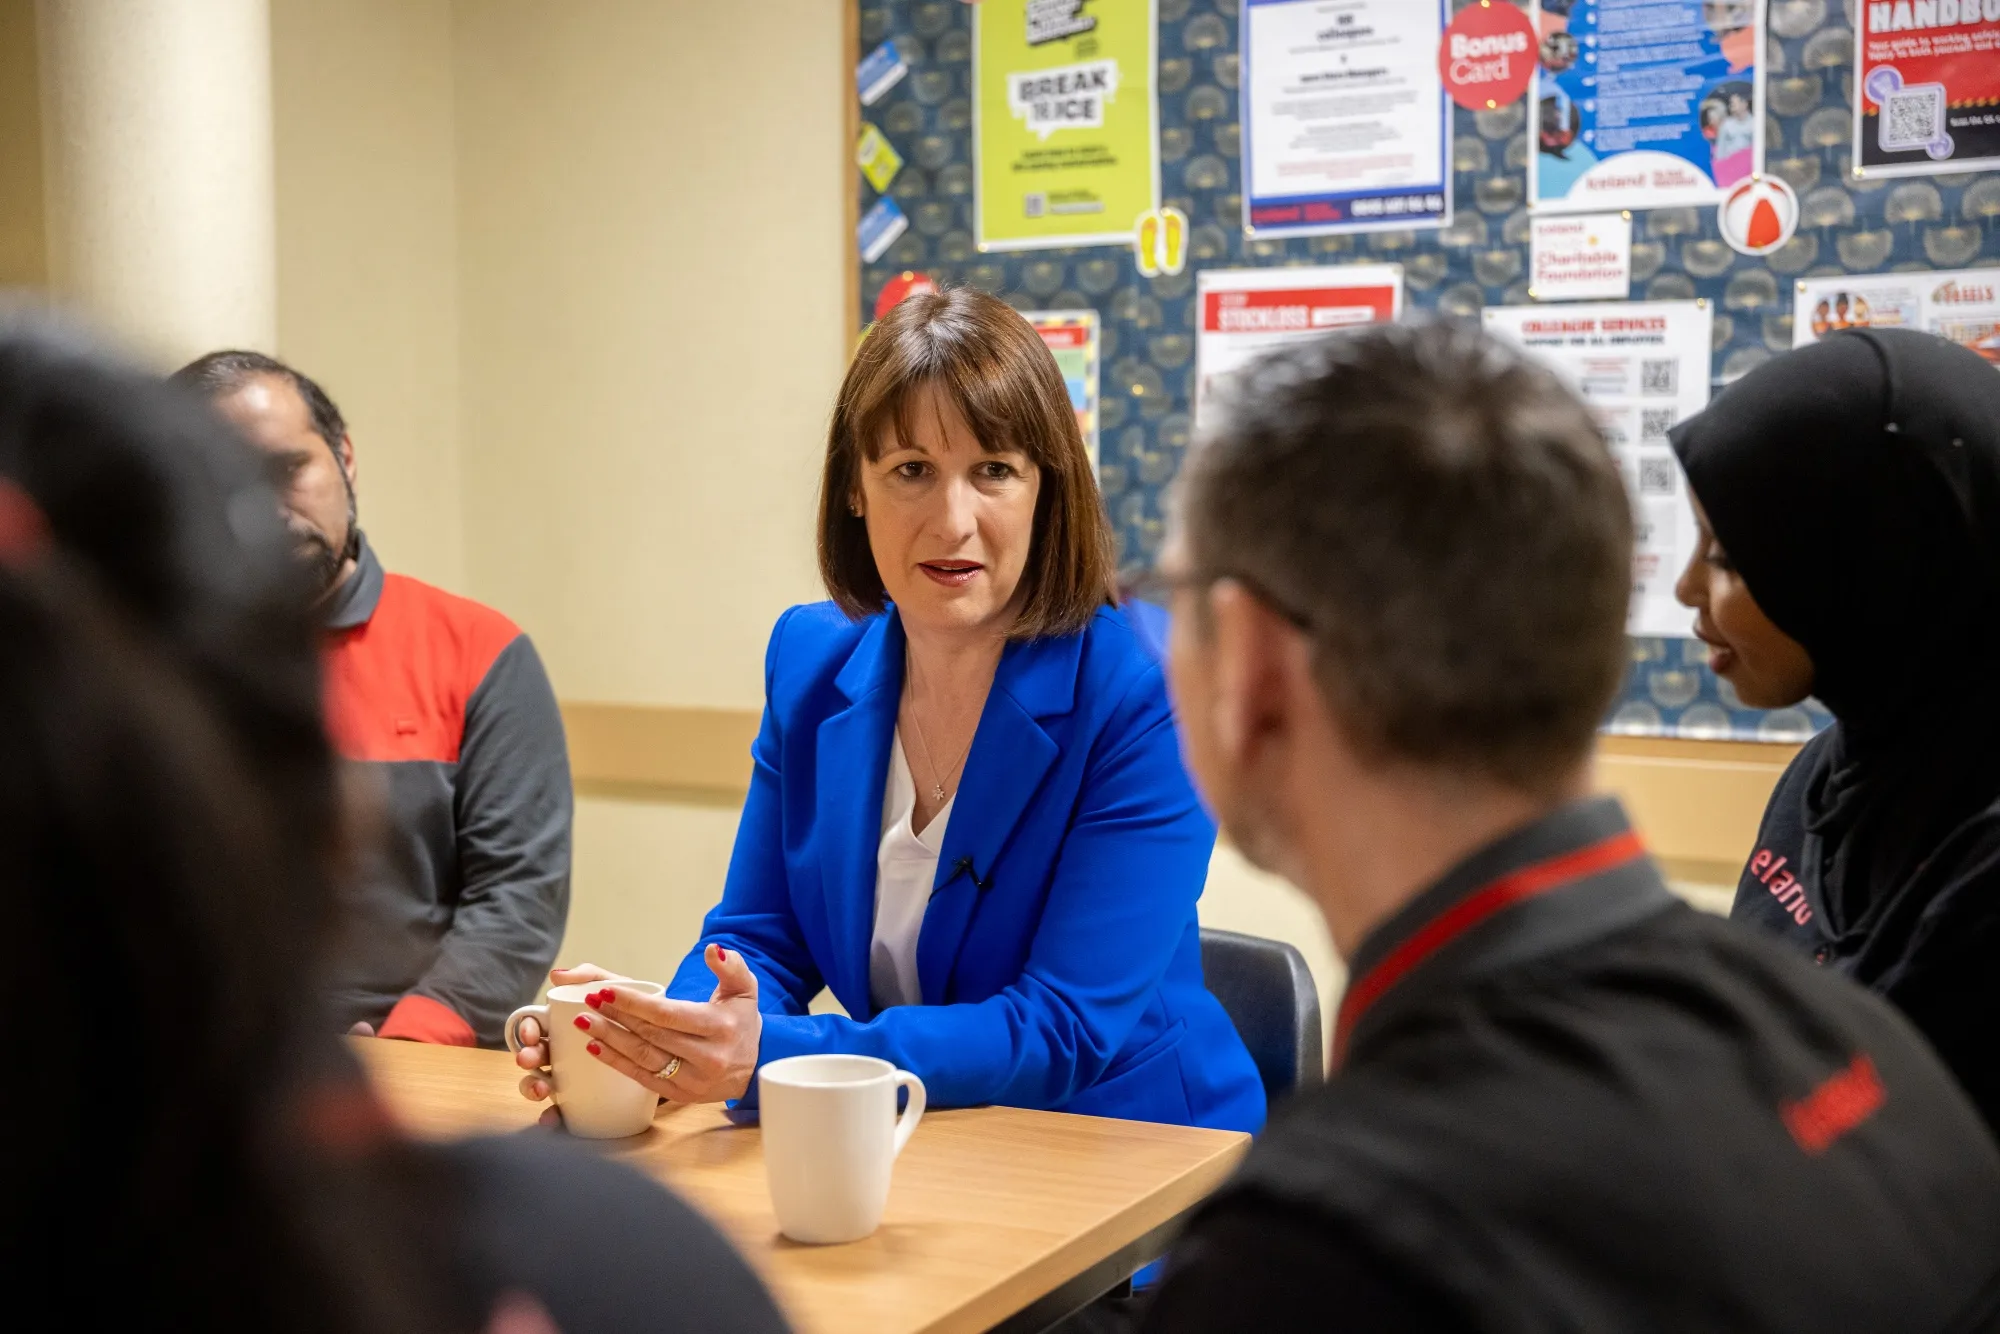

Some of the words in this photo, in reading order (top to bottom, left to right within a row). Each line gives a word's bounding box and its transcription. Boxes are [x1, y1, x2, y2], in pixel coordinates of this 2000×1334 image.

[1450, 31, 1528, 59] Bonus
[1450, 57, 1511, 85] Card
[1019, 67, 1109, 102] BREAK
[1054, 98, 1095, 121] ICE
[1586, 172, 1646, 190] Iceland
[1536, 250, 1619, 267] Charitable
[1536, 267, 1624, 283] Foundation
[1522, 318, 1595, 335] COLLEAGUE
[1601, 315, 1667, 333] SERVICES
